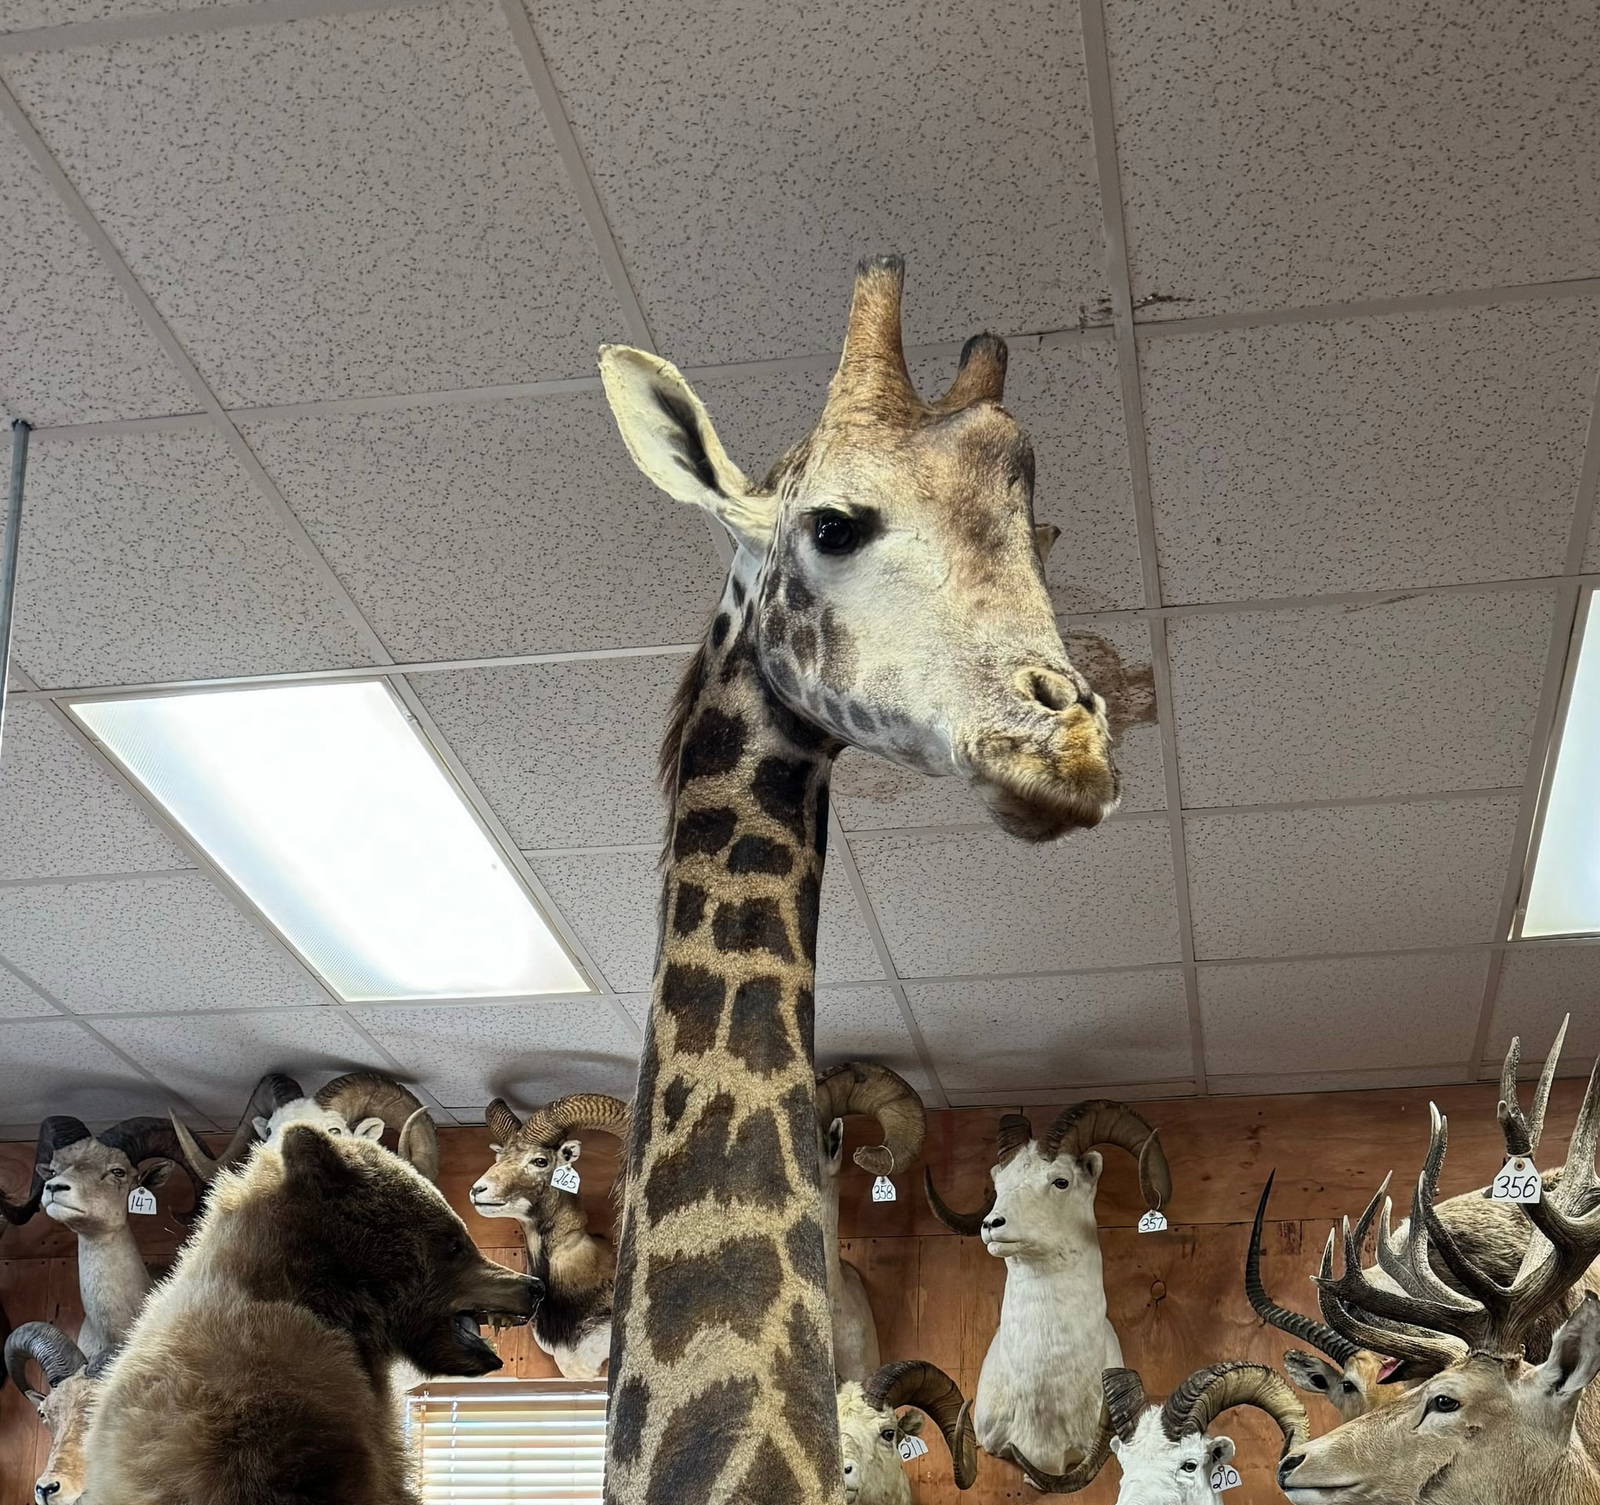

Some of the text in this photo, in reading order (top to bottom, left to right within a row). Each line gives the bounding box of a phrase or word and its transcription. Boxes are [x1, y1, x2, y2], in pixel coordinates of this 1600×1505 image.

[554, 1168, 577, 1189] 265
[1494, 1175, 1538, 1199] 356
[874, 1184, 894, 1200] 358
[131, 1195, 153, 1211] 147
[1140, 1217, 1164, 1231] 357
[900, 1440, 925, 1459] 211
[1212, 1470, 1238, 1489] 210
